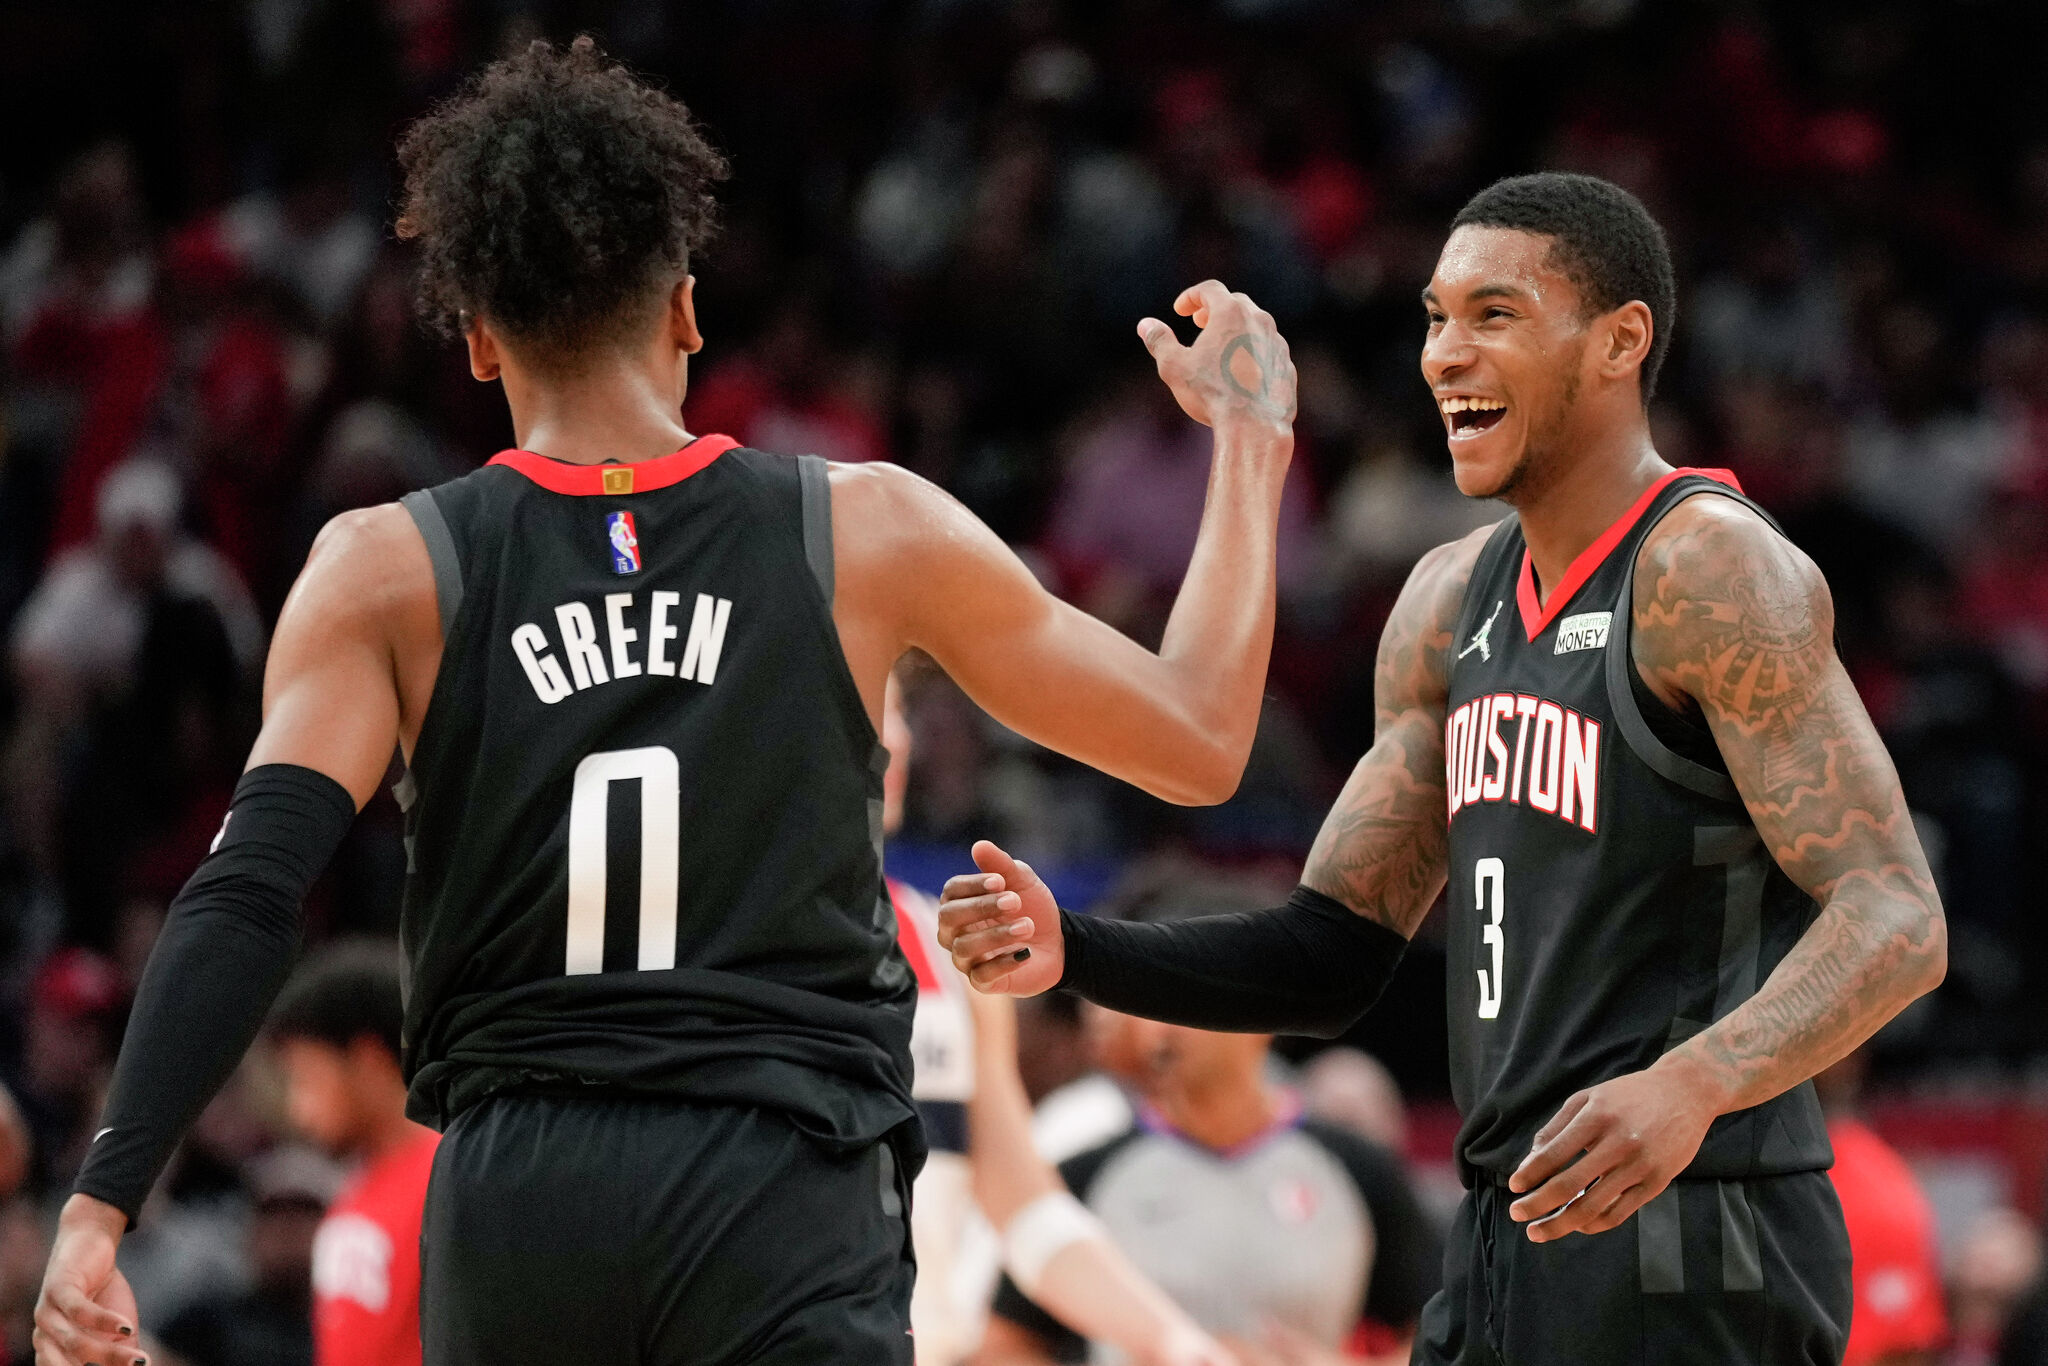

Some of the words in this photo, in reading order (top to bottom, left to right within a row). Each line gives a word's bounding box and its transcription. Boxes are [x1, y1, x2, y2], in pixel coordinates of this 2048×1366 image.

[511, 590, 733, 704] GREEN
[1556, 628, 1605, 653] MONEY
[566, 745, 680, 977] 0
[1475, 857, 1504, 1019] 3
